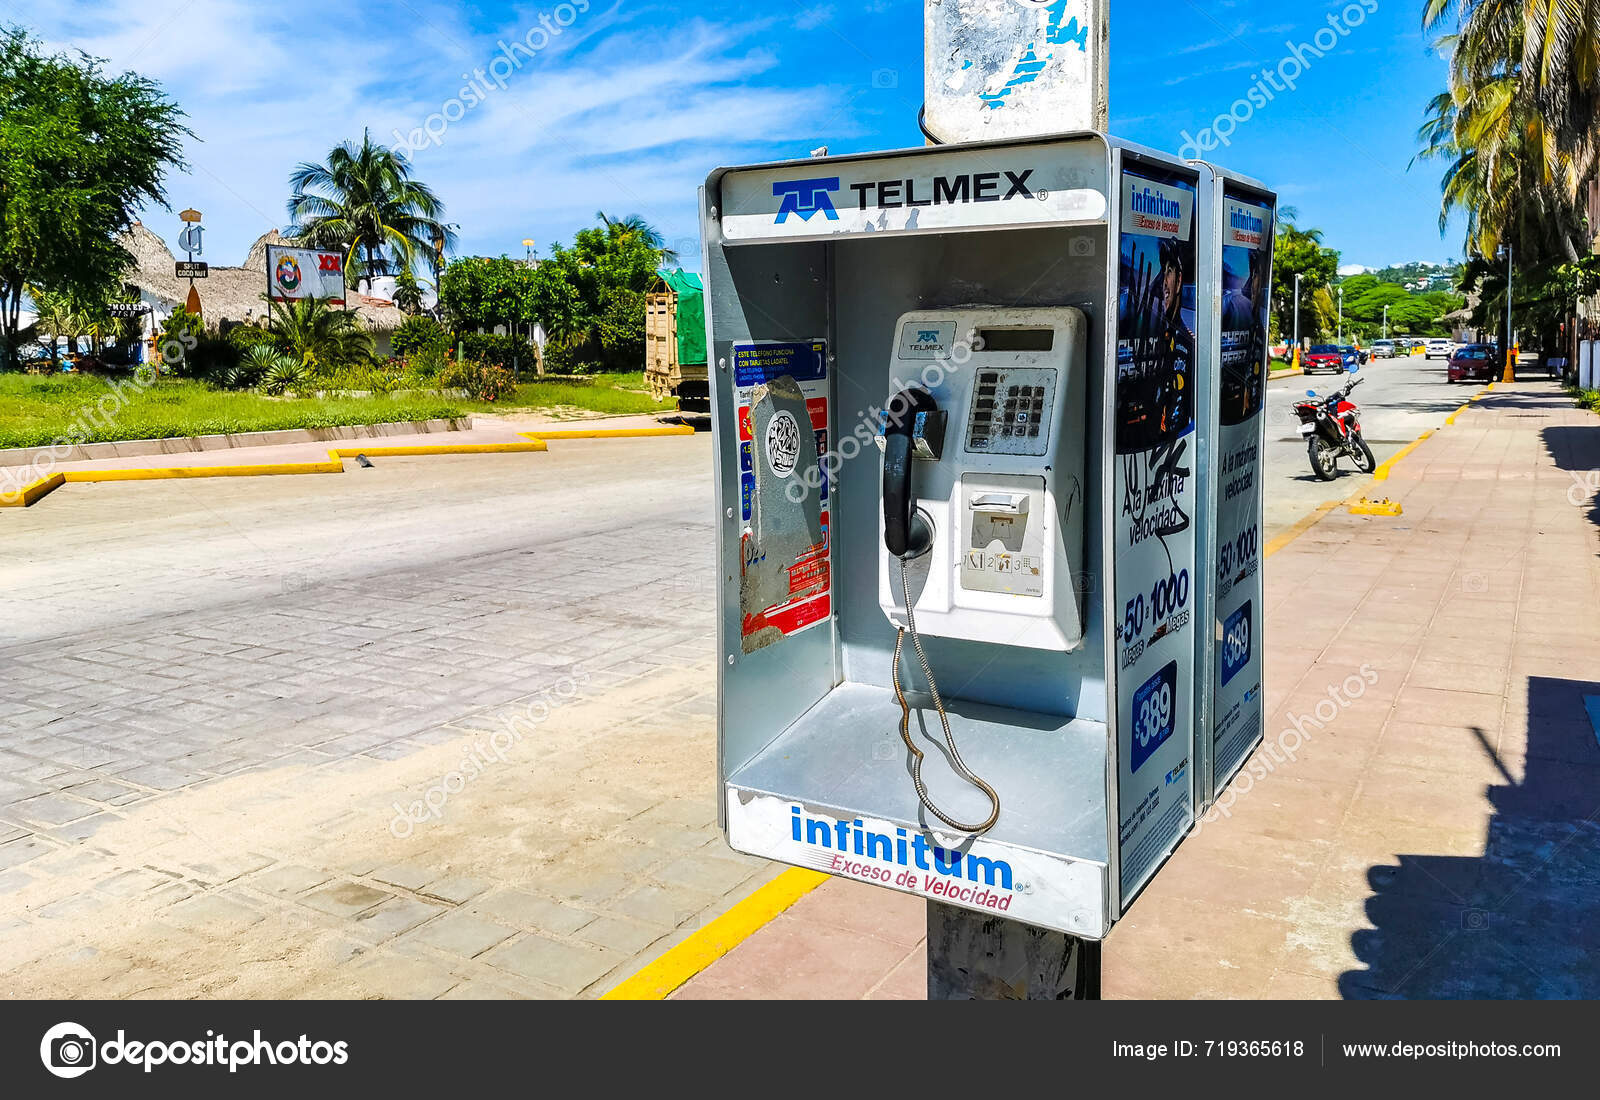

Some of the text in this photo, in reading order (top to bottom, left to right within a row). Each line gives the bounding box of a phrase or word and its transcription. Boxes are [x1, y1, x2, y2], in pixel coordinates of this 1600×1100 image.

[849, 169, 1034, 211] TELMEX
[1131, 185, 1181, 219] infinitum
[1230, 206, 1262, 233] infinitum
[317, 254, 341, 272] XX
[1221, 452, 1227, 477] A
[1227, 450, 1234, 474] la
[1225, 465, 1253, 501] velocidad
[1122, 488, 1131, 518] A
[1132, 492, 1142, 513] la
[1129, 500, 1177, 546] velocidad
[987, 557, 994, 568] 2
[1014, 560, 1021, 571] 3
[1220, 541, 1232, 580] 50
[1236, 523, 1258, 569] 1000
[1124, 593, 1144, 643] 50
[1150, 568, 1189, 625] 1000
[791, 805, 1013, 891] infinitum
[831, 854, 1013, 911] Exceso de Velocidad
